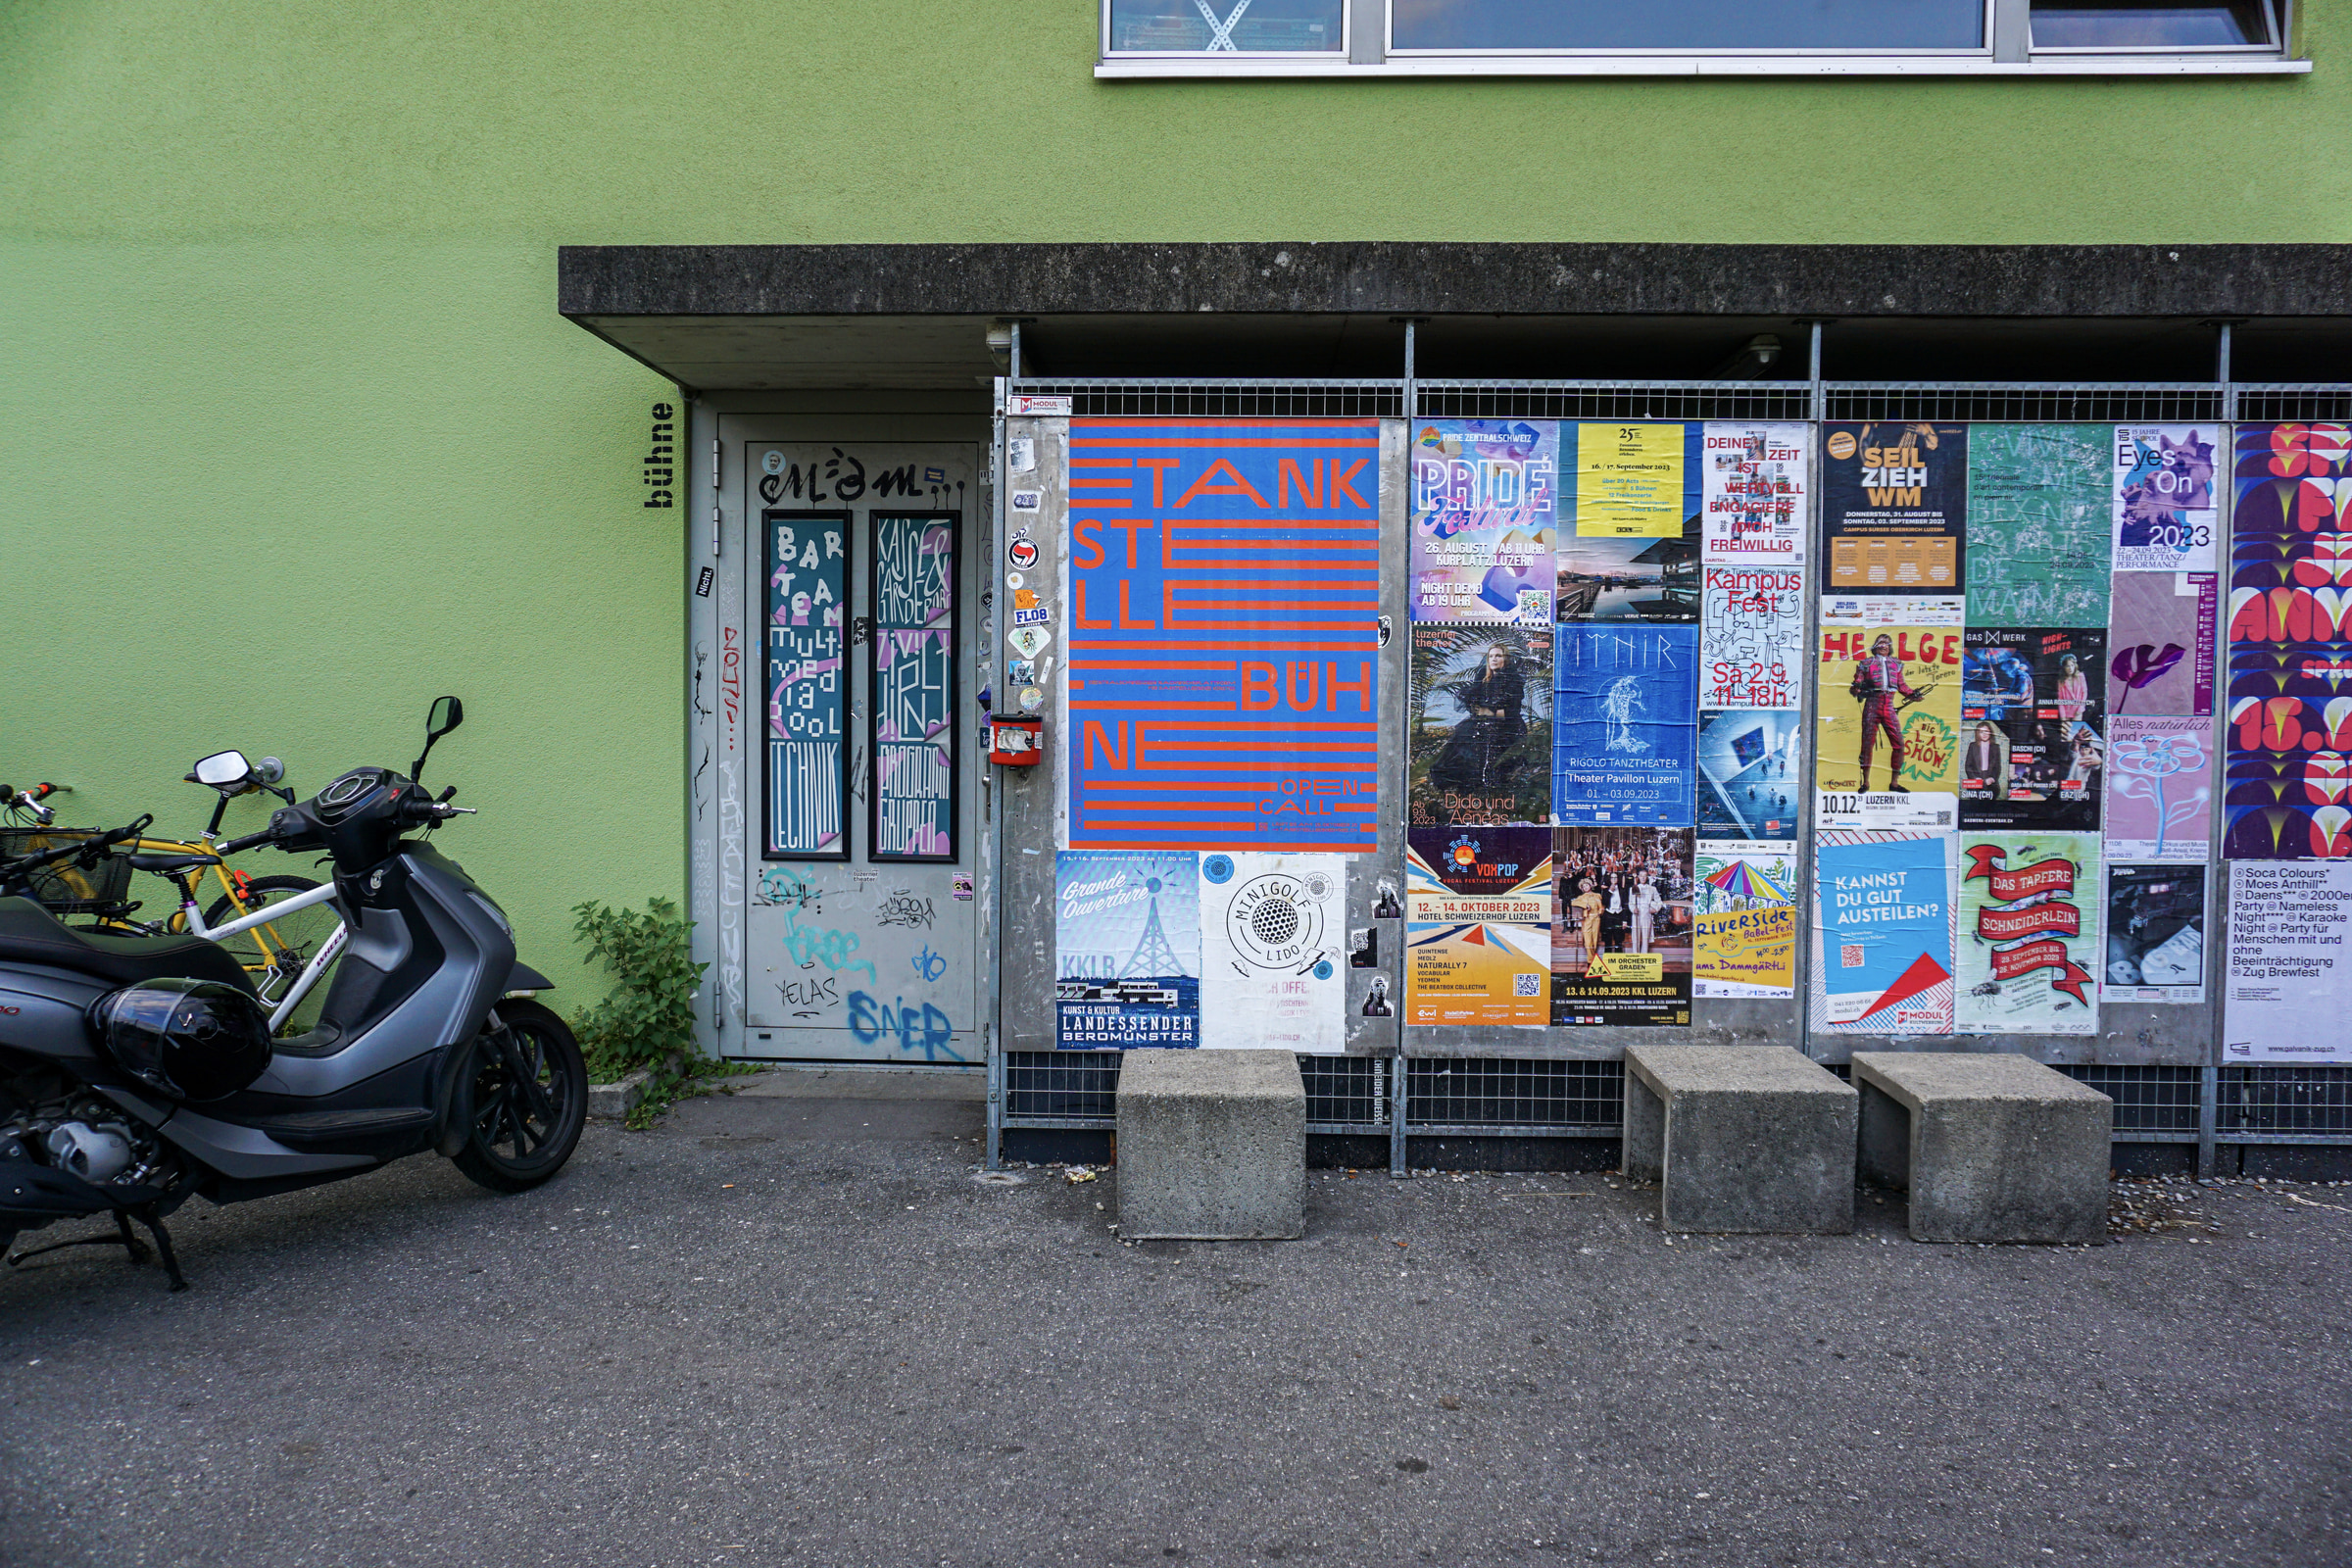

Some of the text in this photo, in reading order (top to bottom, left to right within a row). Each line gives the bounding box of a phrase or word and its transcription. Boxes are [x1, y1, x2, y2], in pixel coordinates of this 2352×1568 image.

[1707, 437, 1751, 449] DEINE
[644, 403, 673, 508] bühne
[1768, 450, 1800, 461] ZEIT
[1864, 448, 1926, 468] SEIL
[2119, 445, 2176, 472] Eyes
[1739, 463, 1761, 473] IST
[1137, 459, 1371, 509] TANK
[1862, 467, 1928, 487] ZIEH
[2157, 470, 2192, 494] On
[1418, 459, 1552, 513] PRIDE
[1725, 483, 1804, 494] WERTVOLL
[1868, 487, 1922, 507] WM
[1418, 488, 1548, 538] Festival
[1710, 502, 1795, 513] ENGAGIERE
[1737, 522, 1773, 533] DICH
[2149, 525, 2210, 547] 2023
[778, 526, 844, 569] BAR
[1425, 543, 1545, 556] 26. AUGUST UHR
[1711, 540, 1793, 551] FREIWILLIG
[877, 518, 951, 599] KASSE
[1437, 555, 1534, 567] KURPLATZ LUZERN
[698, 568, 712, 598] Nicht.
[1421, 583, 1483, 595] NIGHT DEMO
[1707, 568, 1801, 596] Kampus
[775, 573, 843, 626] TEAM
[1421, 595, 1471, 608] AB UHR
[1729, 591, 1779, 612] Fest
[1416, 629, 1457, 639] luzerner
[1416, 638, 1452, 648] theater
[1712, 662, 1789, 684] Sa 2.9.
[1242, 661, 1371, 712] BÜH
[2114, 718, 2212, 731] Alles natürlich
[2113, 731, 2136, 743] und
[1904, 739, 1946, 769] SHOW
[1570, 759, 1679, 768] RIGOLO TANZTHEATER
[1568, 773, 1680, 784] Theater Pavillon Luzern
[770, 742, 839, 849] TECHNIK
[1281, 779, 1357, 796] OPEN
[1588, 789, 1660, 800] 01. 03.09.2023
[1259, 799, 1332, 815] CALL
[1446, 794, 1515, 809] Dido und
[1823, 796, 1861, 814] 10.12.
[1866, 796, 1895, 805] LUZERN
[1896, 796, 1911, 805] KKL
[879, 799, 936, 853] GRUPPEN
[1449, 810, 1509, 826] Aeneas
[1476, 863, 1519, 877] VOXPOP
[2246, 868, 2277, 878] Soca
[1062, 870, 1127, 902] Grande
[1836, 872, 1908, 891] KANNST
[1993, 870, 2071, 891] DAS TAPFERE
[2245, 880, 2278, 889] Moes
[1063, 887, 1150, 919] Ouverture
[1236, 882, 1311, 921] MINIGOLF
[1837, 889, 1903, 907] DU GUT
[1418, 903, 1541, 912] 12. 14. OKTOBER 2023
[1838, 904, 1939, 925] AUSTEILEN?
[2234, 902, 2338, 914] Party Nameless
[1983, 910, 2076, 932] SCHNEIDERLEIN
[2299, 912, 2347, 922] Karaoke
[2234, 923, 2329, 936] Night Party für
[317, 928, 348, 967] WHEELE
[2233, 935, 2342, 945] Menschen mit und
[1267, 945, 1300, 961] LIDO
[2233, 946, 2263, 956] ohne
[1063, 956, 1116, 979] KKLB
[2233, 956, 2333, 968] Beeinträchtigung
[2243, 967, 2321, 979] Zug Brewfest
[1648, 987, 1677, 996] LUZERN
[1063, 1005, 1086, 1014] KUNST
[1063, 1017, 1192, 1031] LANDESSENDER
[1063, 1029, 1193, 1041] BEROMÜNSTER
[1374, 1059, 1383, 1097] CHNEIDER
